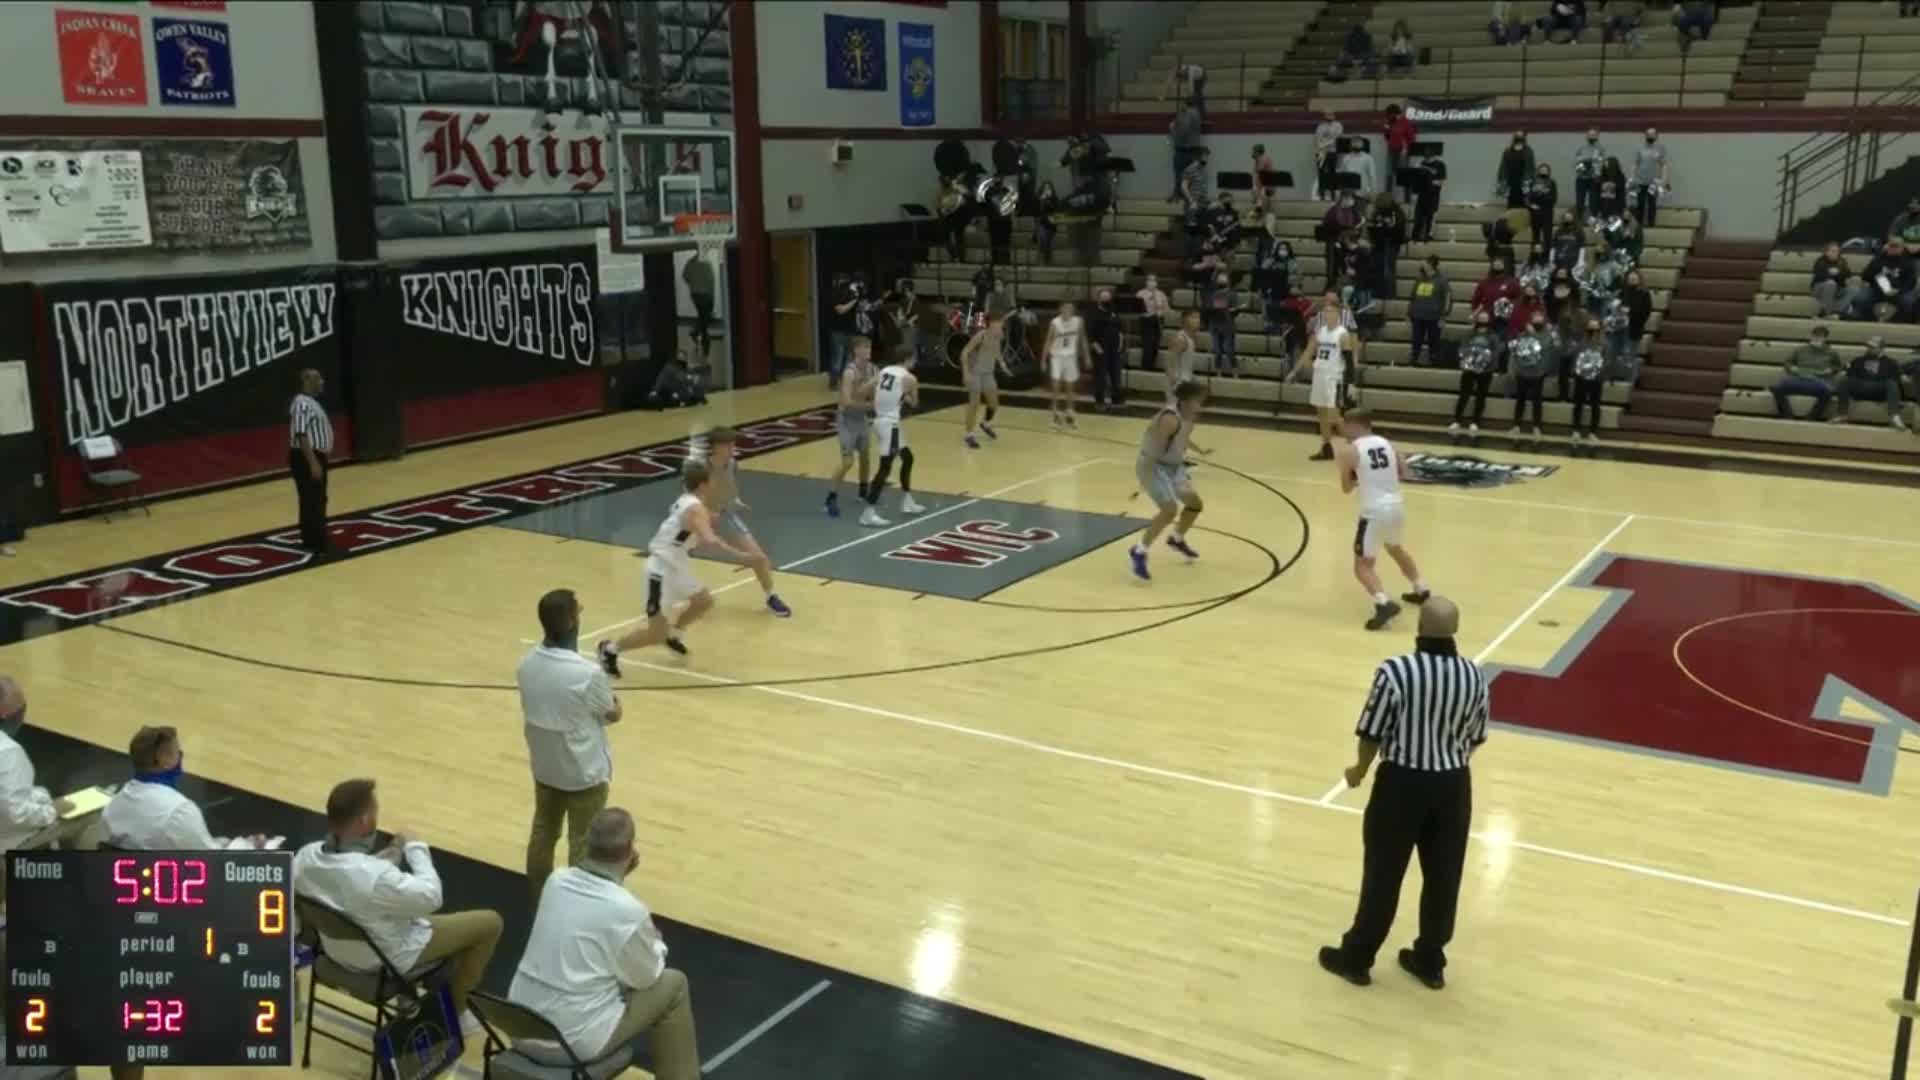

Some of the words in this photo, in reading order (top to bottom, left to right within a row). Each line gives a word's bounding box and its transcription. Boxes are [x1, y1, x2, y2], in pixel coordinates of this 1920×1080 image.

[156, 24, 187, 41] OWEN
[189, 23, 227, 45] VALLEY
[166, 88, 230, 101] PATRIOTS
[400, 262, 595, 366] KNIGHTS
[53, 283, 336, 446] NORTHVIEW
[880, 372, 896, 392] 23
[1367, 447, 1390, 470] 35
[880, 519, 1060, 568] WIC
